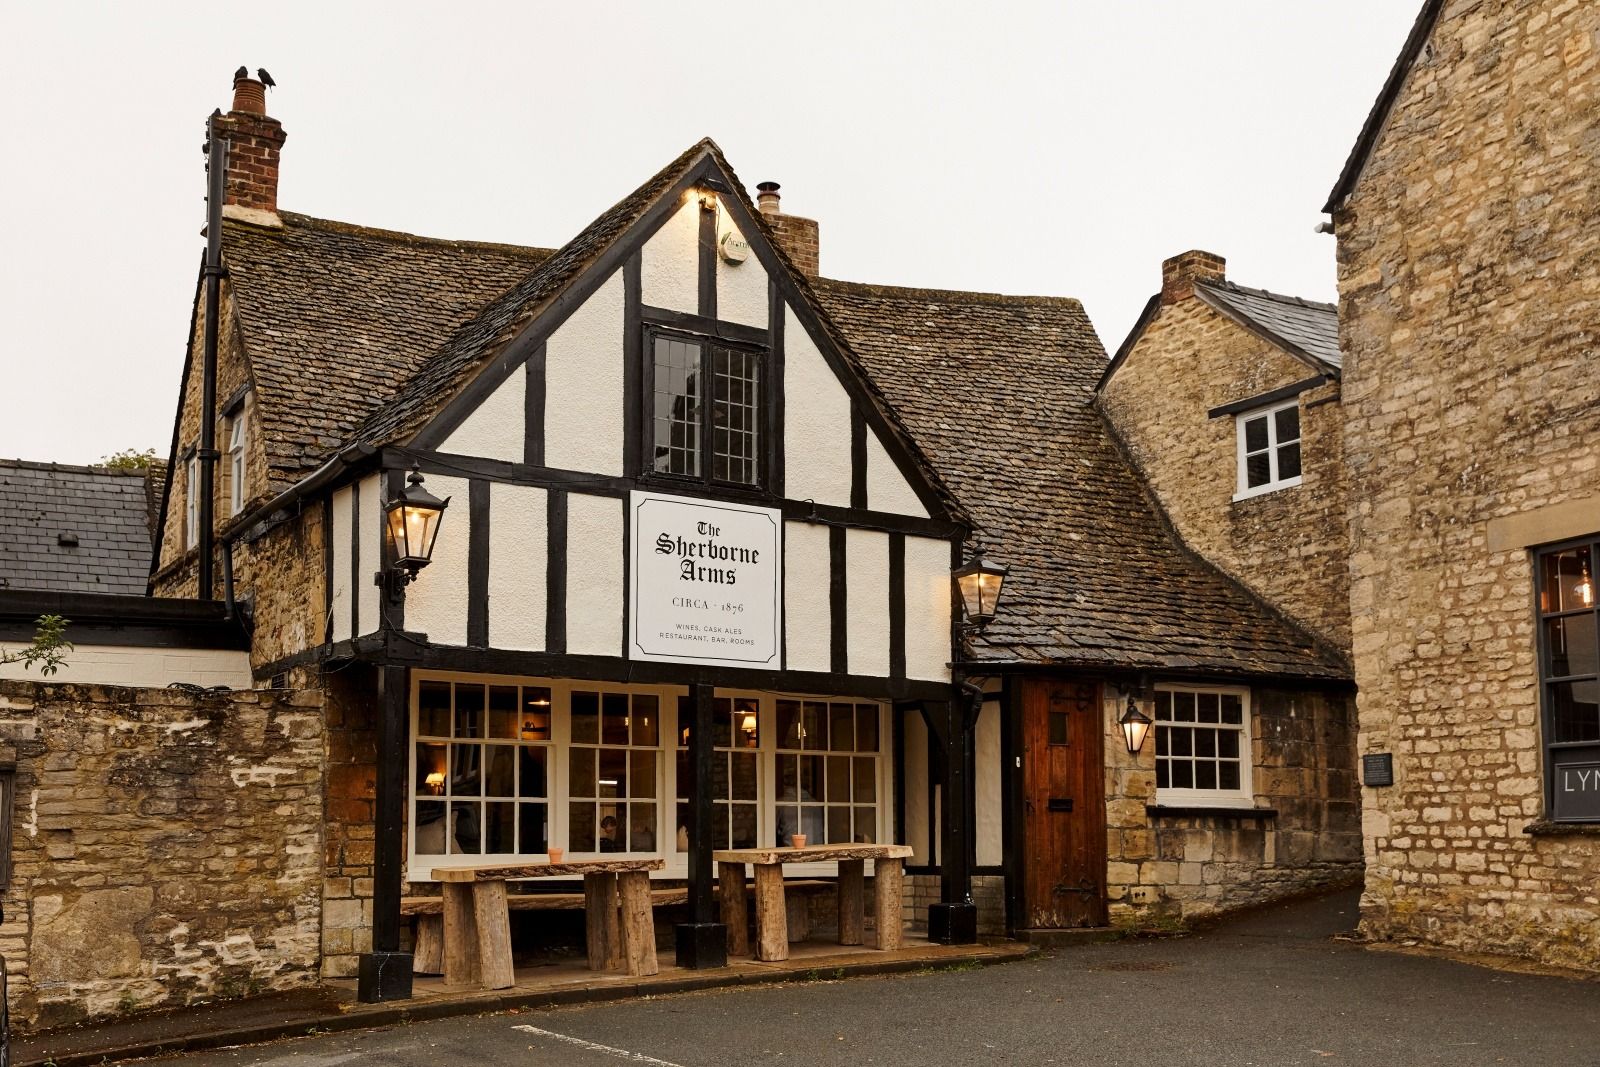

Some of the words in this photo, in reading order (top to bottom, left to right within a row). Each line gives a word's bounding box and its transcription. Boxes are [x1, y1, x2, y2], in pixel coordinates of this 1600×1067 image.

[697, 521, 720, 537] The
[655, 532, 760, 564] Sherborne
[680, 559, 736, 585] Arms
[672, 597, 709, 610] CIRCA
[721, 603, 744, 615] 1876
[676, 624, 701, 632] WINES,
[659, 632, 709, 643] RESTAURANT,
[711, 636, 728, 644] BAR,
[730, 638, 755, 646] ROOMS
